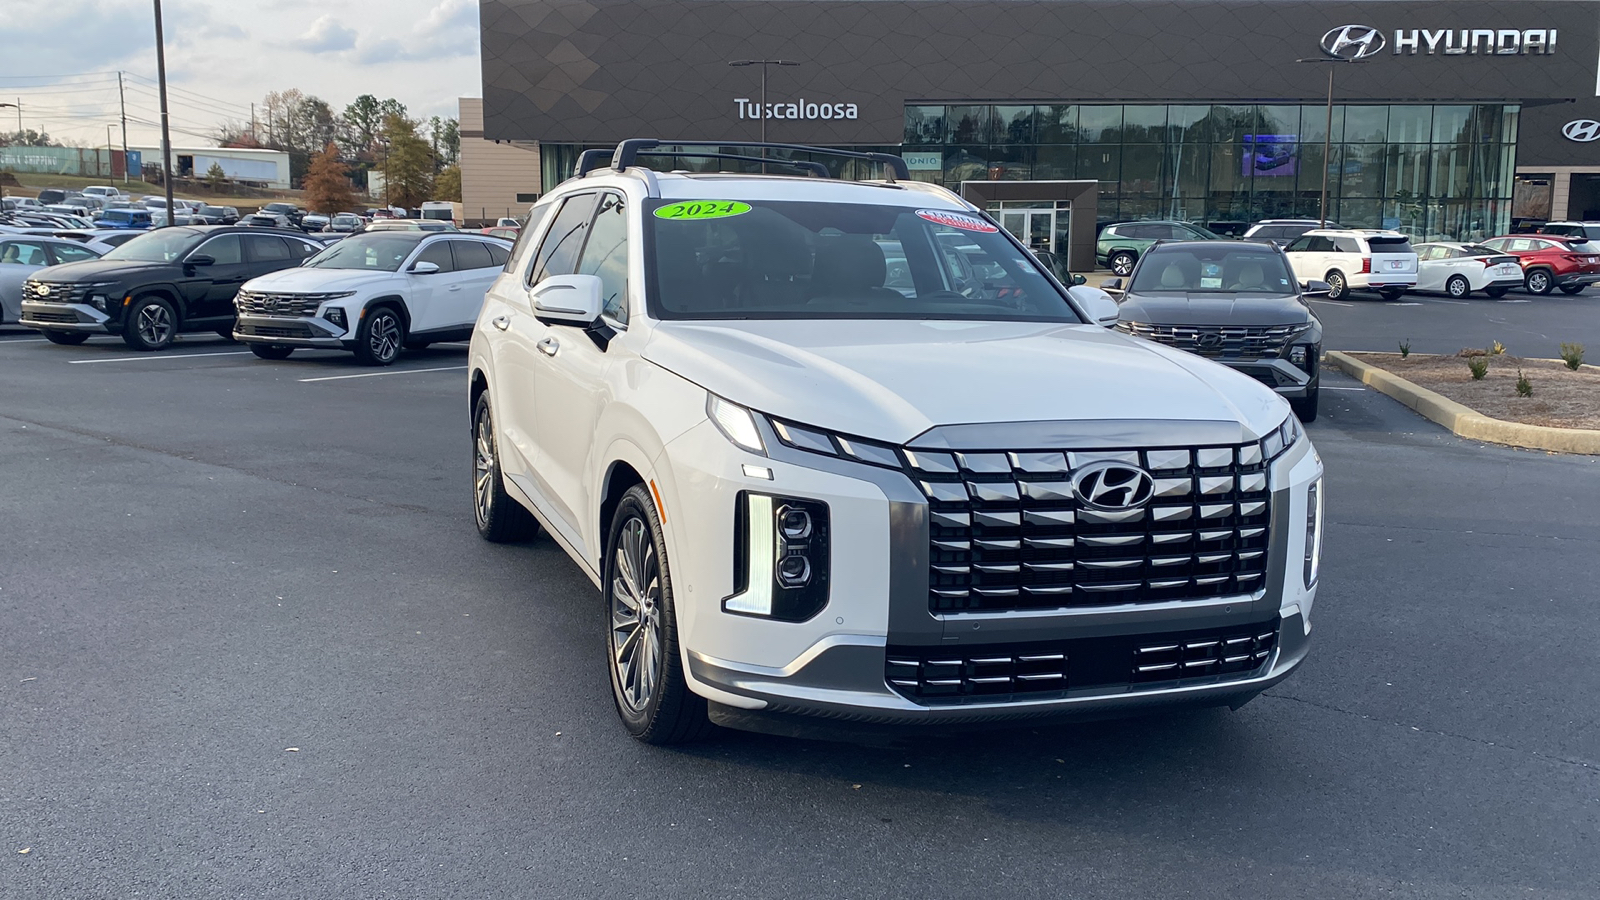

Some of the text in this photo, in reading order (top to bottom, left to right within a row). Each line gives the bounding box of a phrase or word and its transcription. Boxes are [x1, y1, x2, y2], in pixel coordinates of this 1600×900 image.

[1393, 28, 1558, 55] HYUNDAI
[733, 98, 858, 119] Tuscaloosa
[669, 202, 735, 218] 2024
